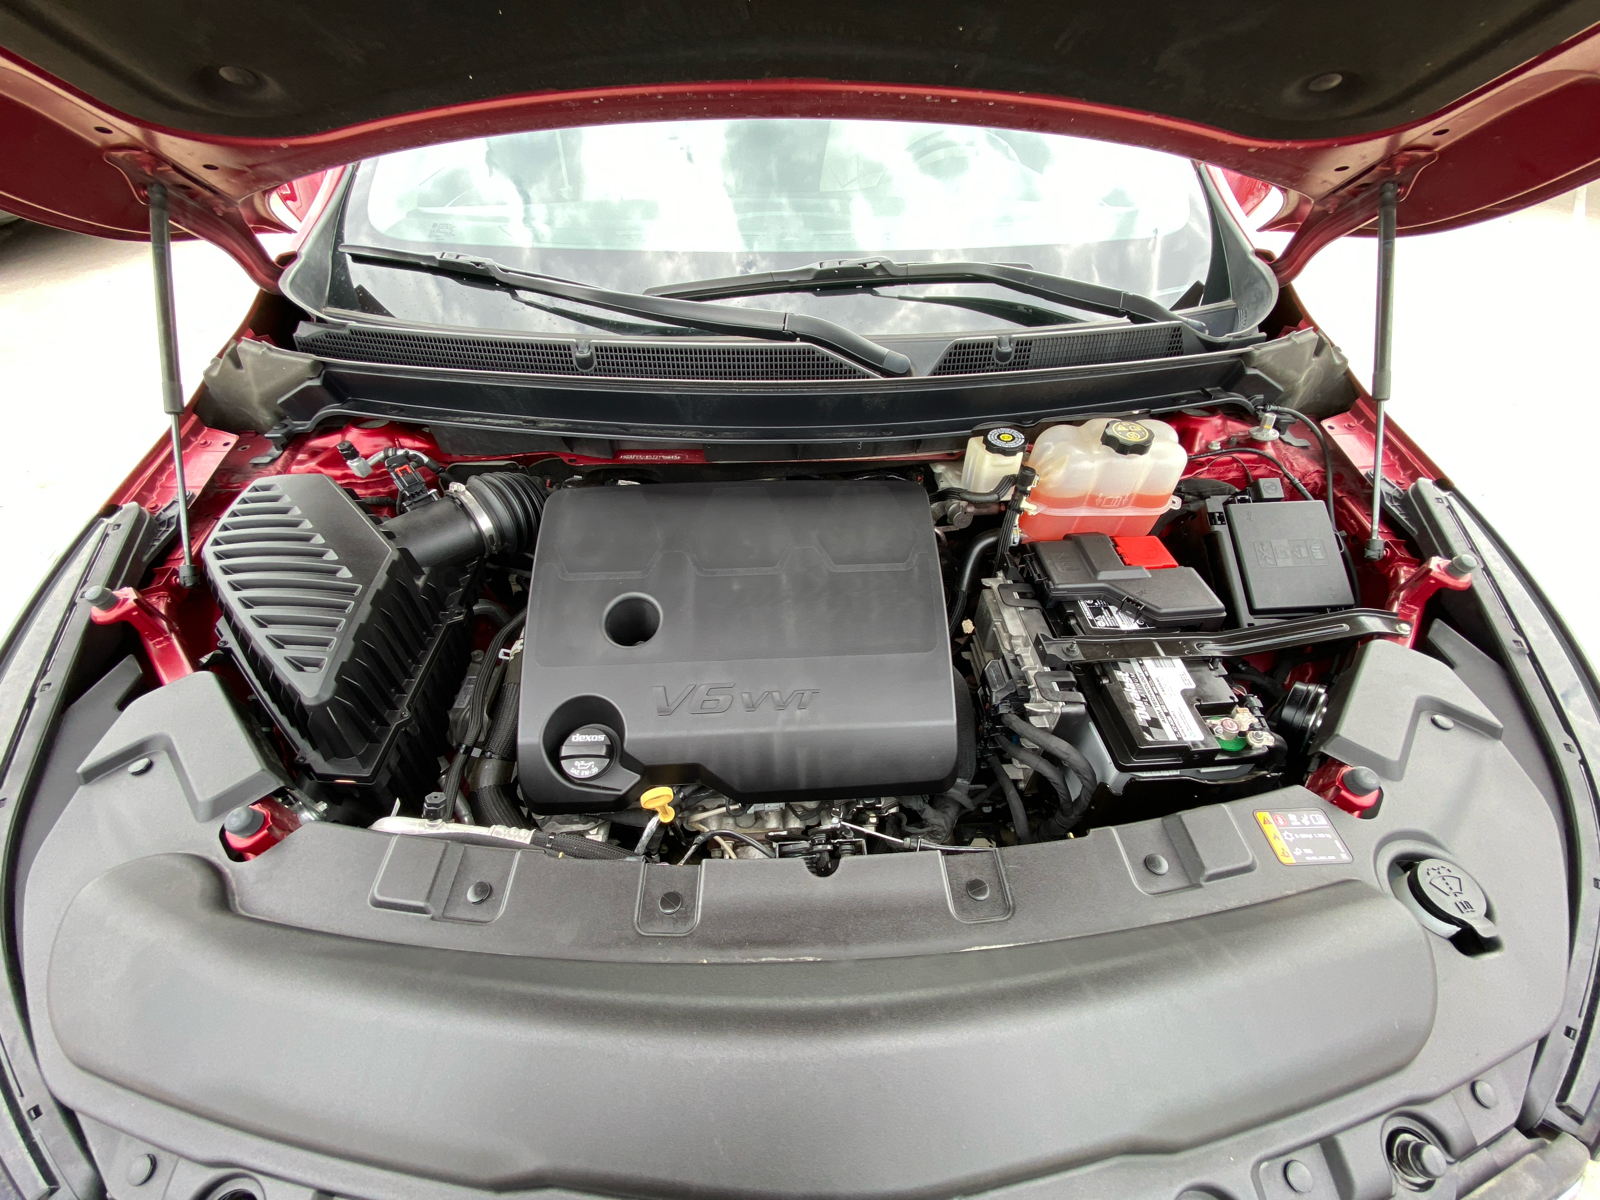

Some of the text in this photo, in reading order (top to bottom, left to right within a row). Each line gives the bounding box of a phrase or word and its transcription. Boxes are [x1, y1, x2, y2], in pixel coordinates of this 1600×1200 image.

[651, 682, 821, 716] V6 VVT
[1117, 669, 1152, 721] Duralast
[1129, 672, 1151, 706] PLATINUM
[1138, 671, 1160, 708] TECHNOLOGY
[1157, 709, 1167, 724] AGM
[571, 733, 606, 742] dexos
[570, 767, 580, 776] SAE
